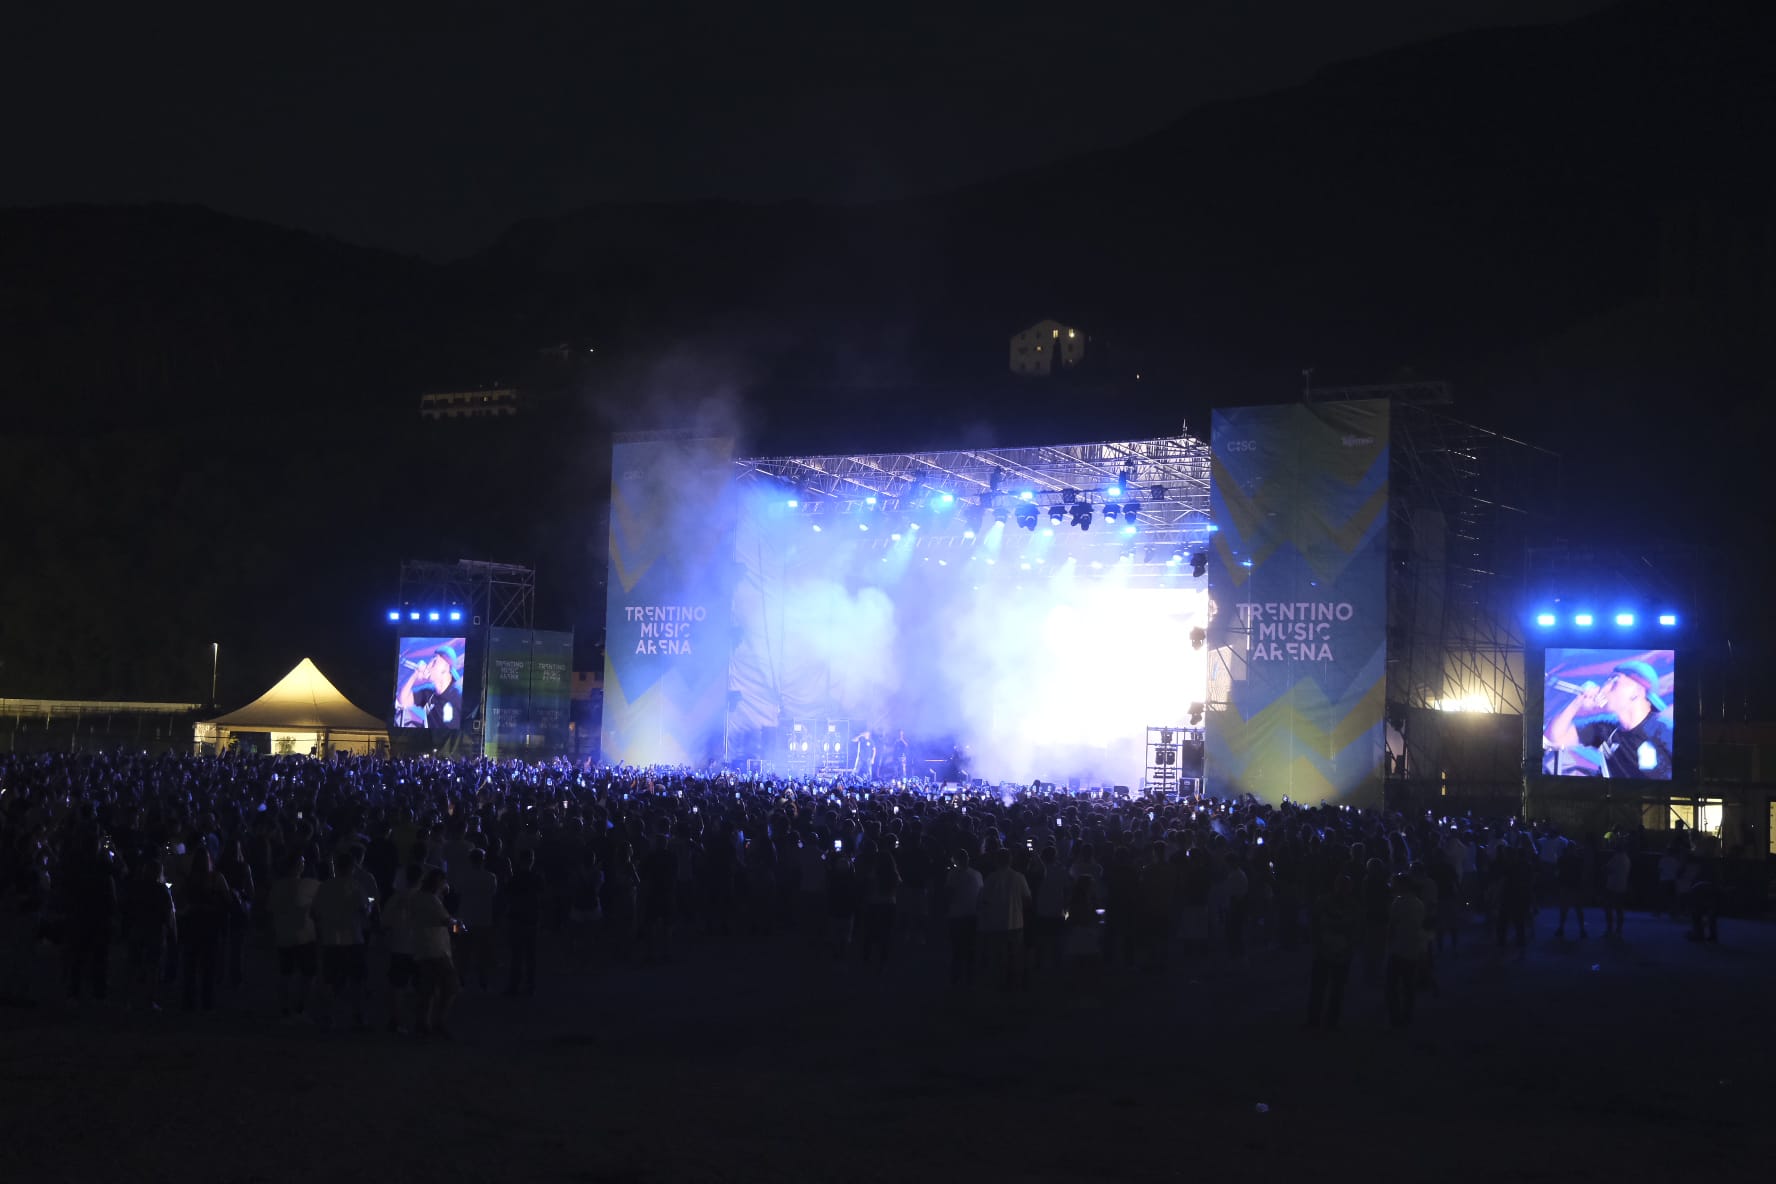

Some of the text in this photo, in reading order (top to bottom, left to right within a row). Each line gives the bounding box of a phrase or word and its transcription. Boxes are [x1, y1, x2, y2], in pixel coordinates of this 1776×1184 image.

[624, 606, 706, 621] TRENTINO
[1236, 602, 1353, 621] TRENTINO
[640, 622, 690, 638] MUSIC
[1259, 622, 1331, 641] MUSIC
[635, 639, 692, 655] ARENA
[1252, 642, 1334, 661] ARENA
